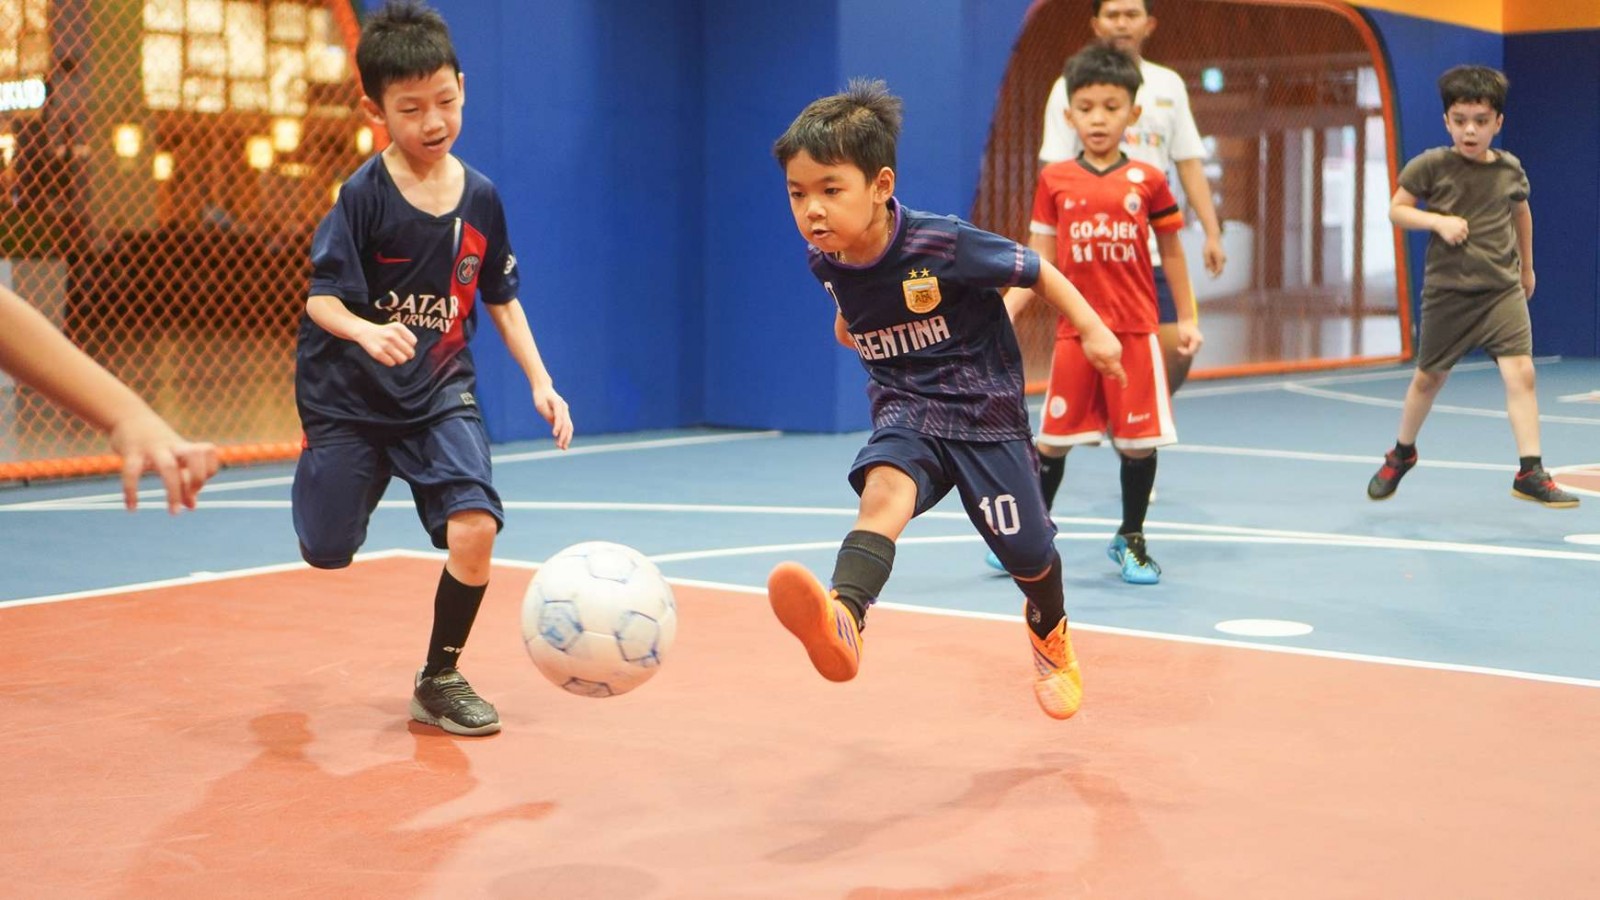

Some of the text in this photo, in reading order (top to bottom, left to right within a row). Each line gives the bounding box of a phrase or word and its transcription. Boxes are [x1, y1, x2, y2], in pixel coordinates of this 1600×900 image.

[1097, 242, 1137, 262] TOA
[375, 290, 459, 319] QATAR
[854, 315, 951, 361] GENTINA
[979, 493, 1021, 536] 10
